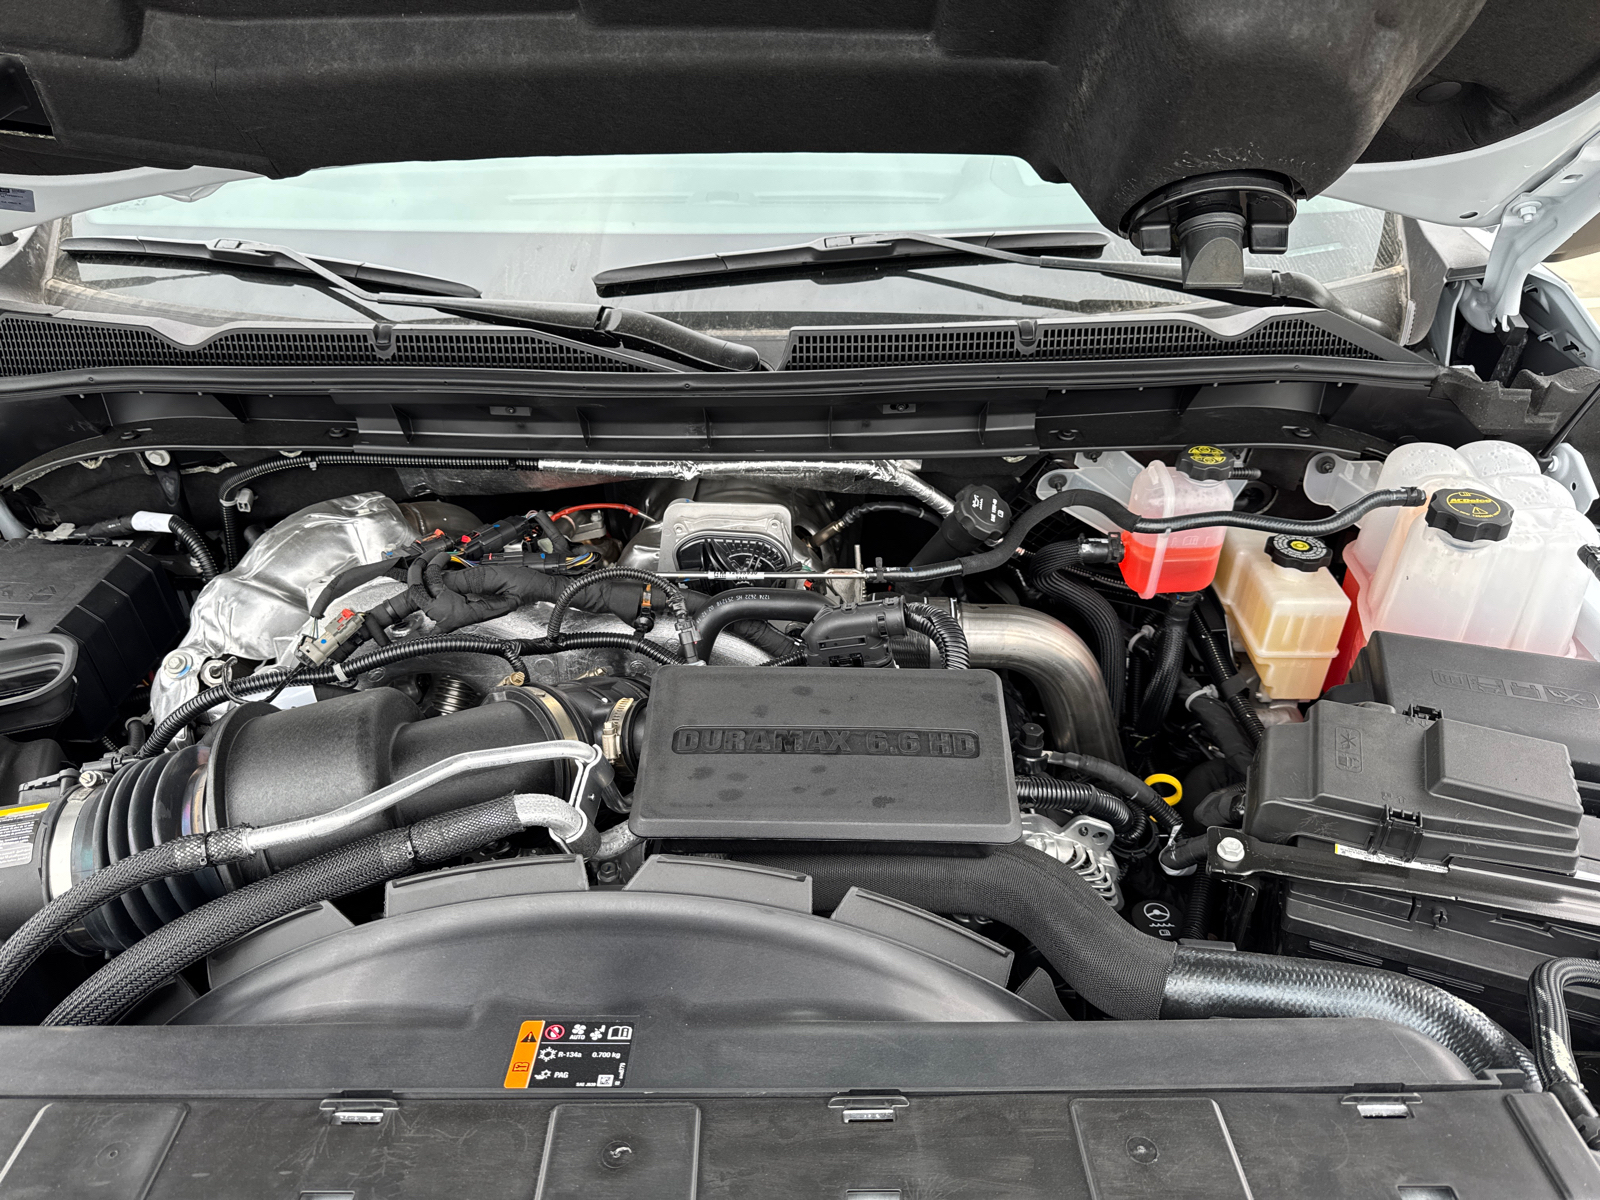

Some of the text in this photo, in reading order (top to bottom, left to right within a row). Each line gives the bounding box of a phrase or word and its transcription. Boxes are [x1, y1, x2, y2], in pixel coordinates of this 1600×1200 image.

[676, 728, 977, 757] DURAMAX 6.6 HD
[611, 1051, 621, 1059] kg
